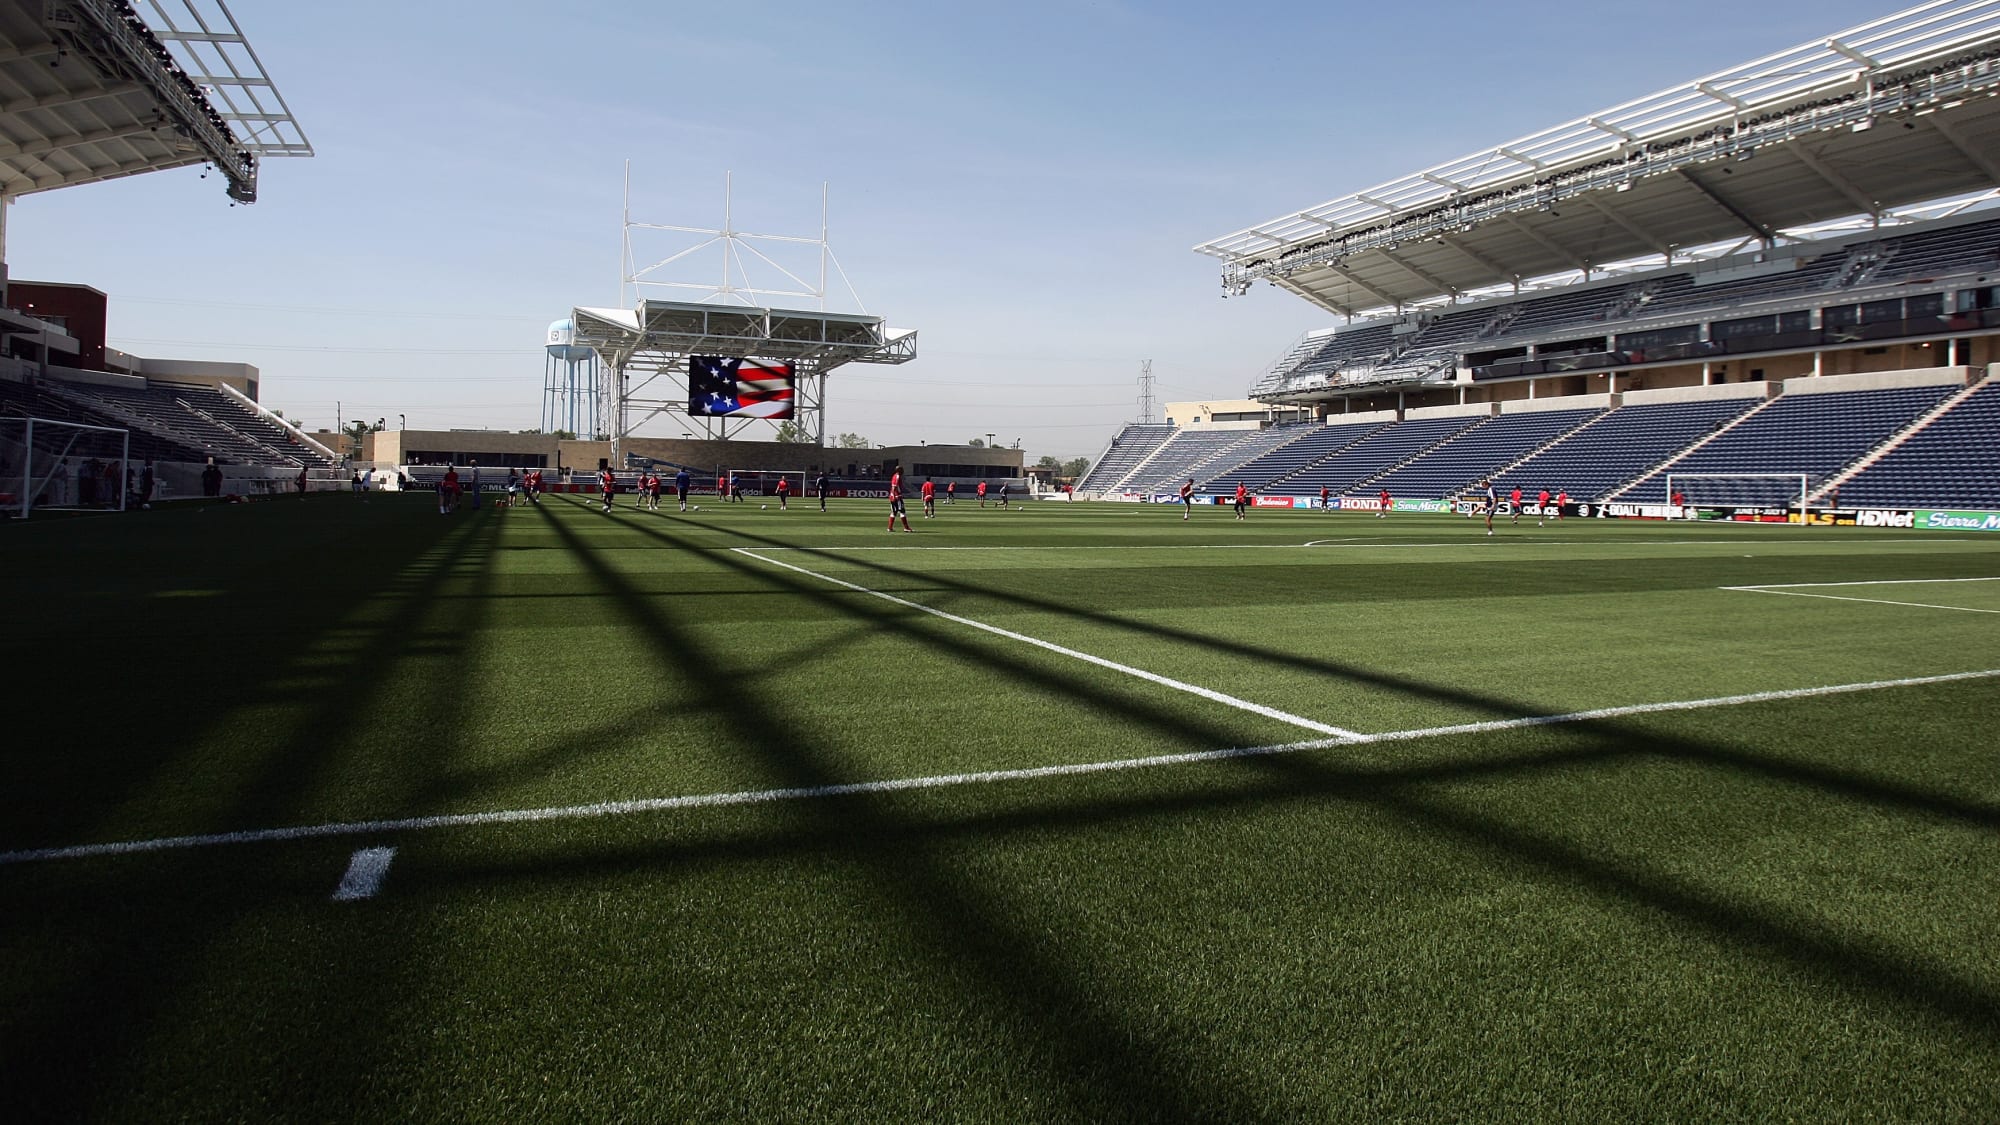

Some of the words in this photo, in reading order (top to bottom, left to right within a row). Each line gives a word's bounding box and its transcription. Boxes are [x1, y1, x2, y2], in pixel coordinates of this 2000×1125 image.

[740, 488, 761, 496] didas
[847, 489, 889, 498] HOND
[1256, 496, 1288, 506] Budweiser
[1471, 503, 1509, 513] MS
[1856, 510, 1915, 527] HDNet
[1927, 512, 1981, 528] Sierra
